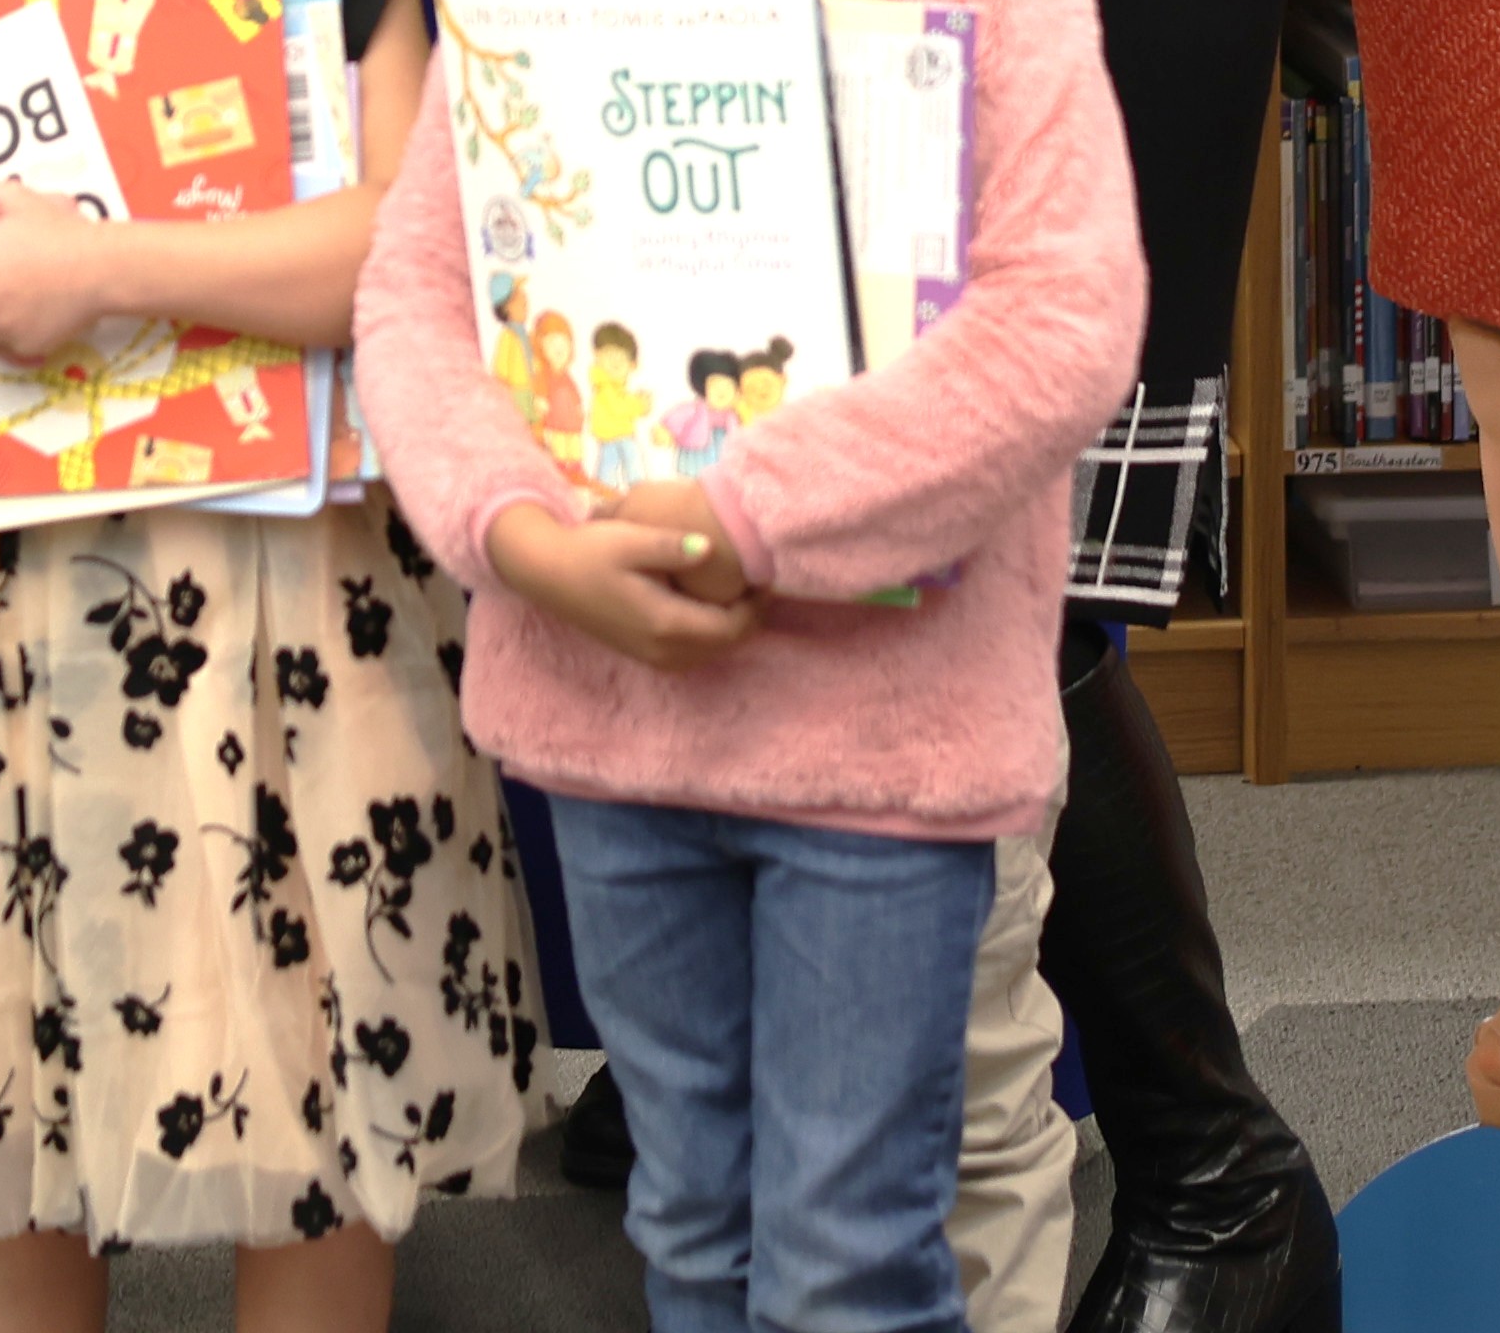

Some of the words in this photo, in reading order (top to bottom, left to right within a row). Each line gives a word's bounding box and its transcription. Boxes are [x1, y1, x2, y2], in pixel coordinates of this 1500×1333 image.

[601, 68, 793, 137] STEPPIN'
[642, 137, 761, 215] OUT
[1296, 451, 1338, 473] 975
